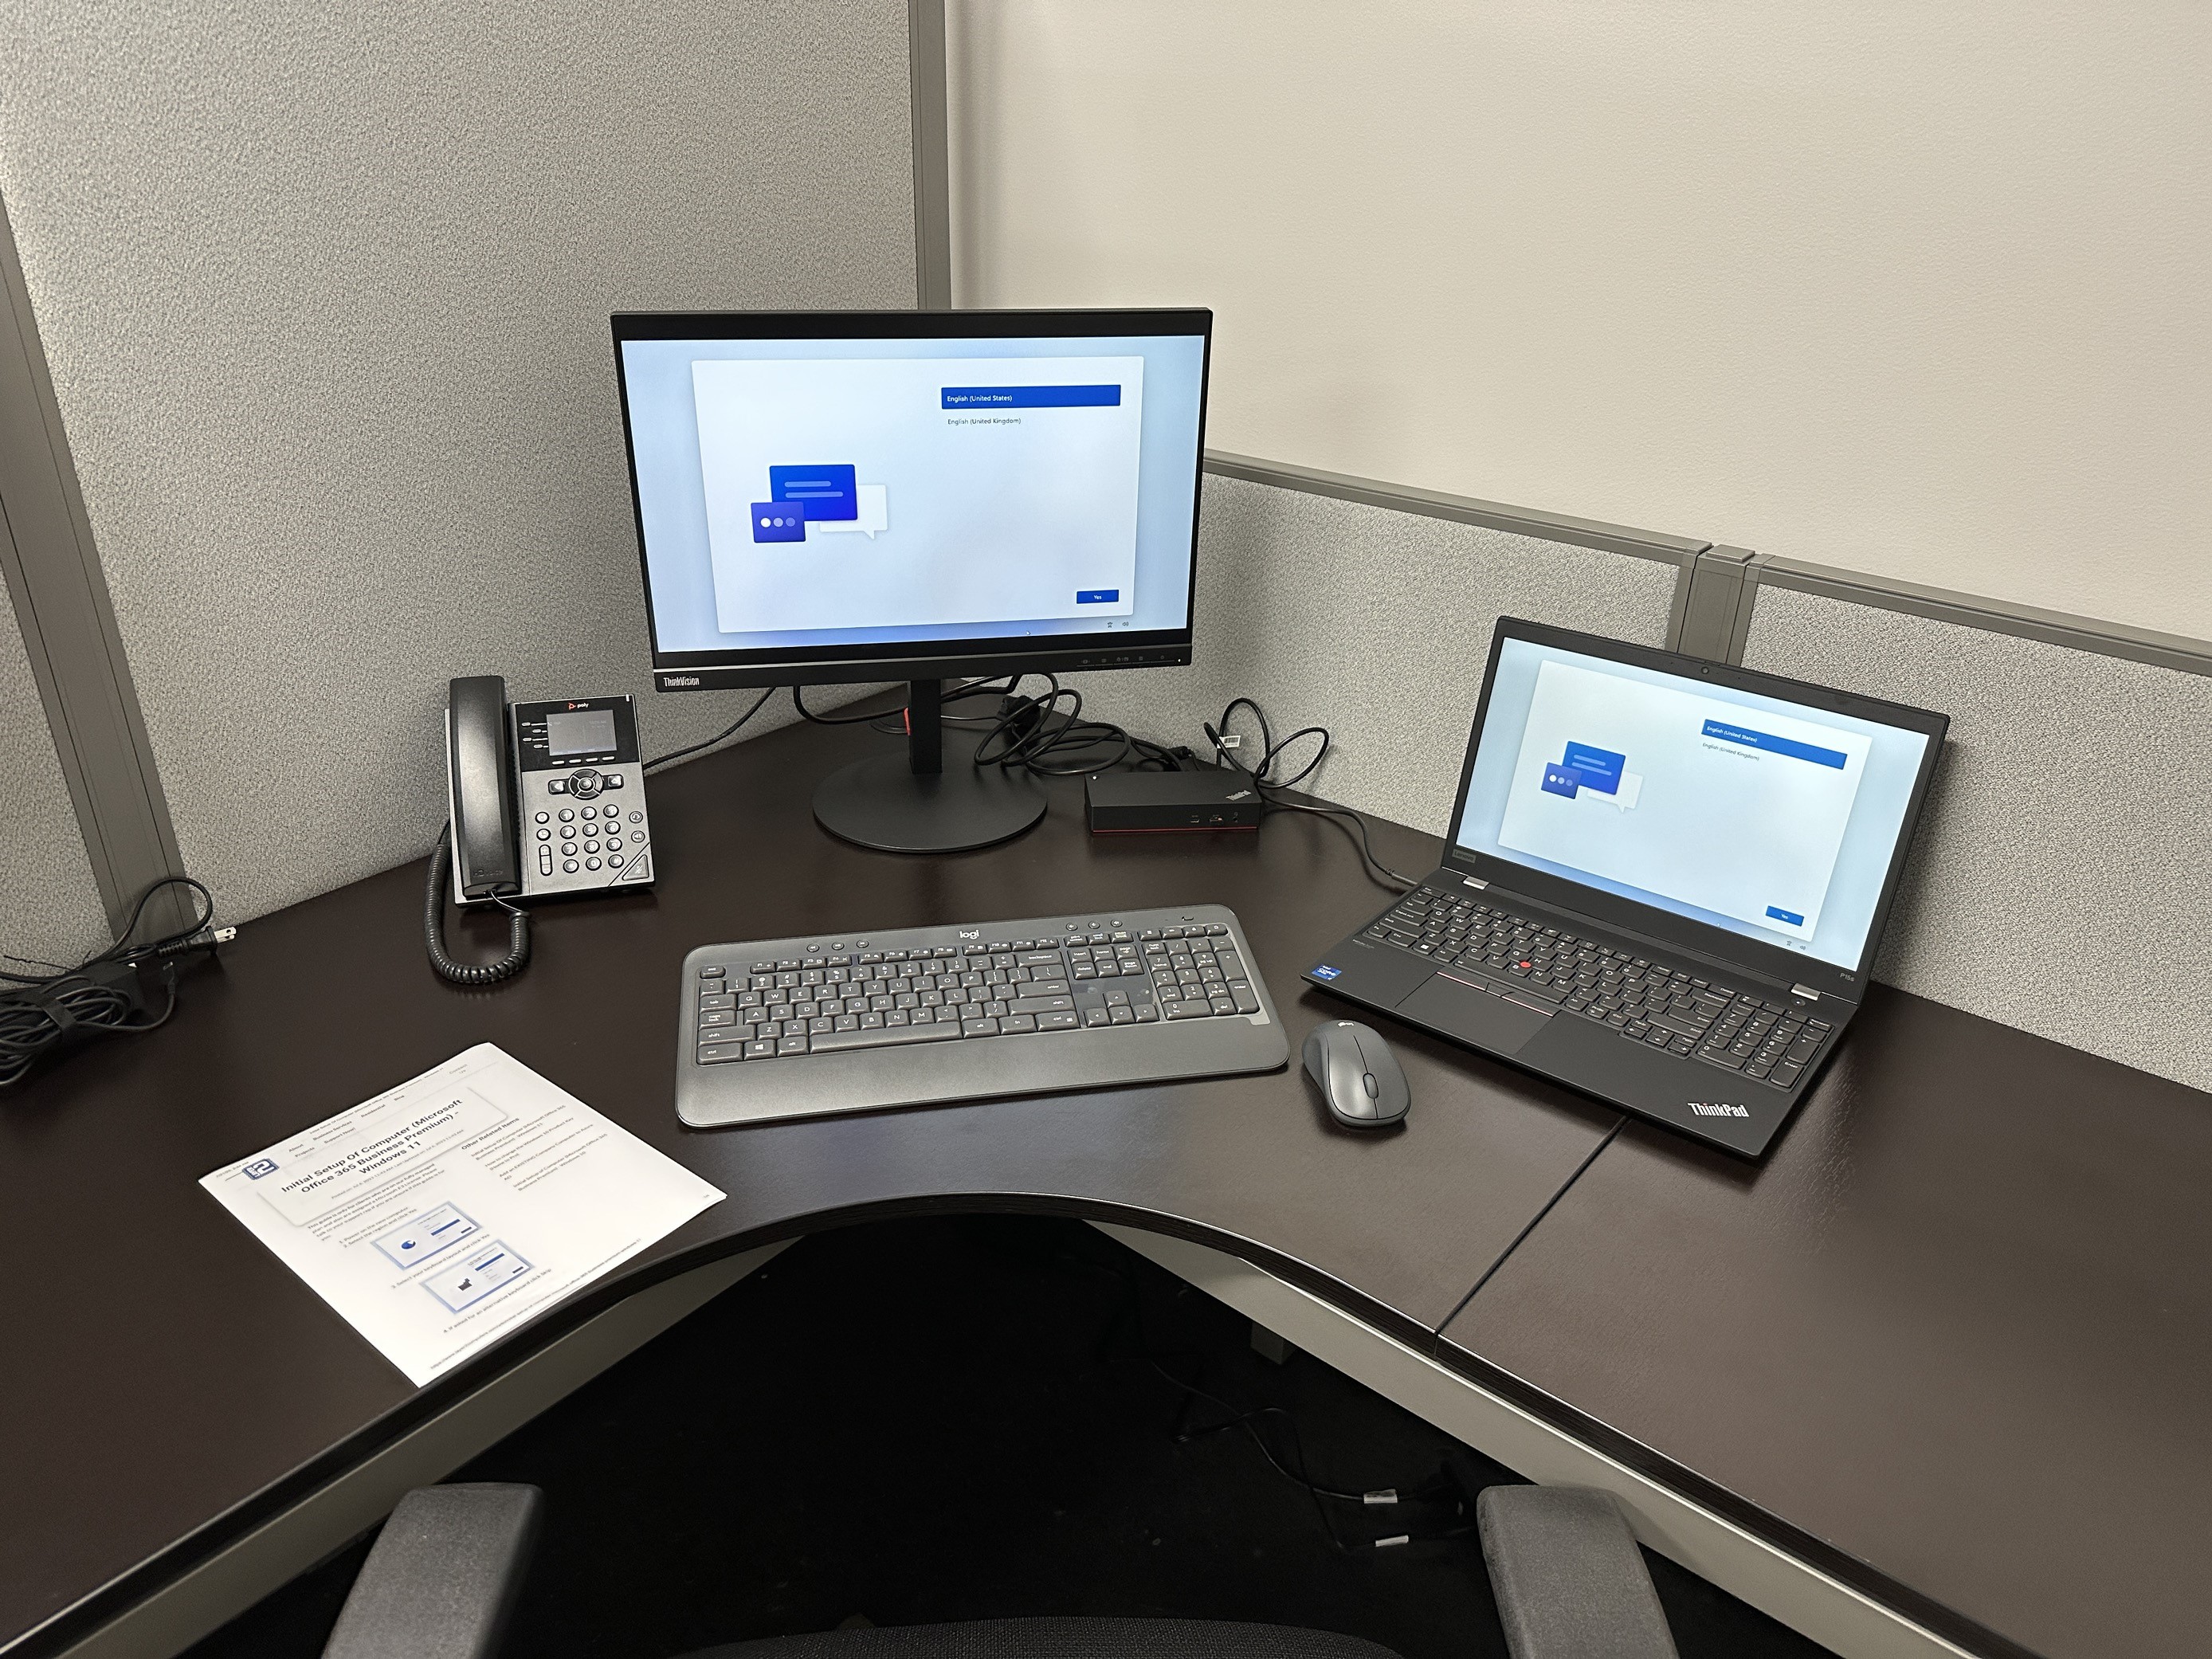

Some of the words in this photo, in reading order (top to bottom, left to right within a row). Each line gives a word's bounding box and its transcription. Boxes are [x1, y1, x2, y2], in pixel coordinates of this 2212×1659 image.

[663, 676, 699, 686] ThinkVision
[1741, 734, 1757, 743] States)
[1737, 751, 1759, 761] Kingdom)
[960, 930, 979, 939] logi
[1687, 1102, 1749, 1117] ThinkPad
[289, 1144, 303, 1152] About
[312, 1130, 333, 1141] Business
[333, 1121, 352, 1131] Services
[361, 1104, 385, 1117] Residential
[461, 1140, 478, 1149] Other
[478, 1126, 502, 1140] Related
[501, 1118, 519, 1128] Items
[281, 1174, 313, 1192] Initial
[314, 1160, 345, 1176] Setup
[347, 1151, 359, 1160] Of
[361, 1127, 409, 1152] Computer
[411, 1100, 462, 1127] (Microsoft
[295, 1147, 314, 1157] Projects
[324, 1133, 343, 1143] Support
[301, 1176, 334, 1192] Office
[335, 1164, 356, 1176] 365
[357, 1141, 404, 1165] Business
[404, 1114, 453, 1141] Premium)
[359, 1150, 406, 1173] Windows
